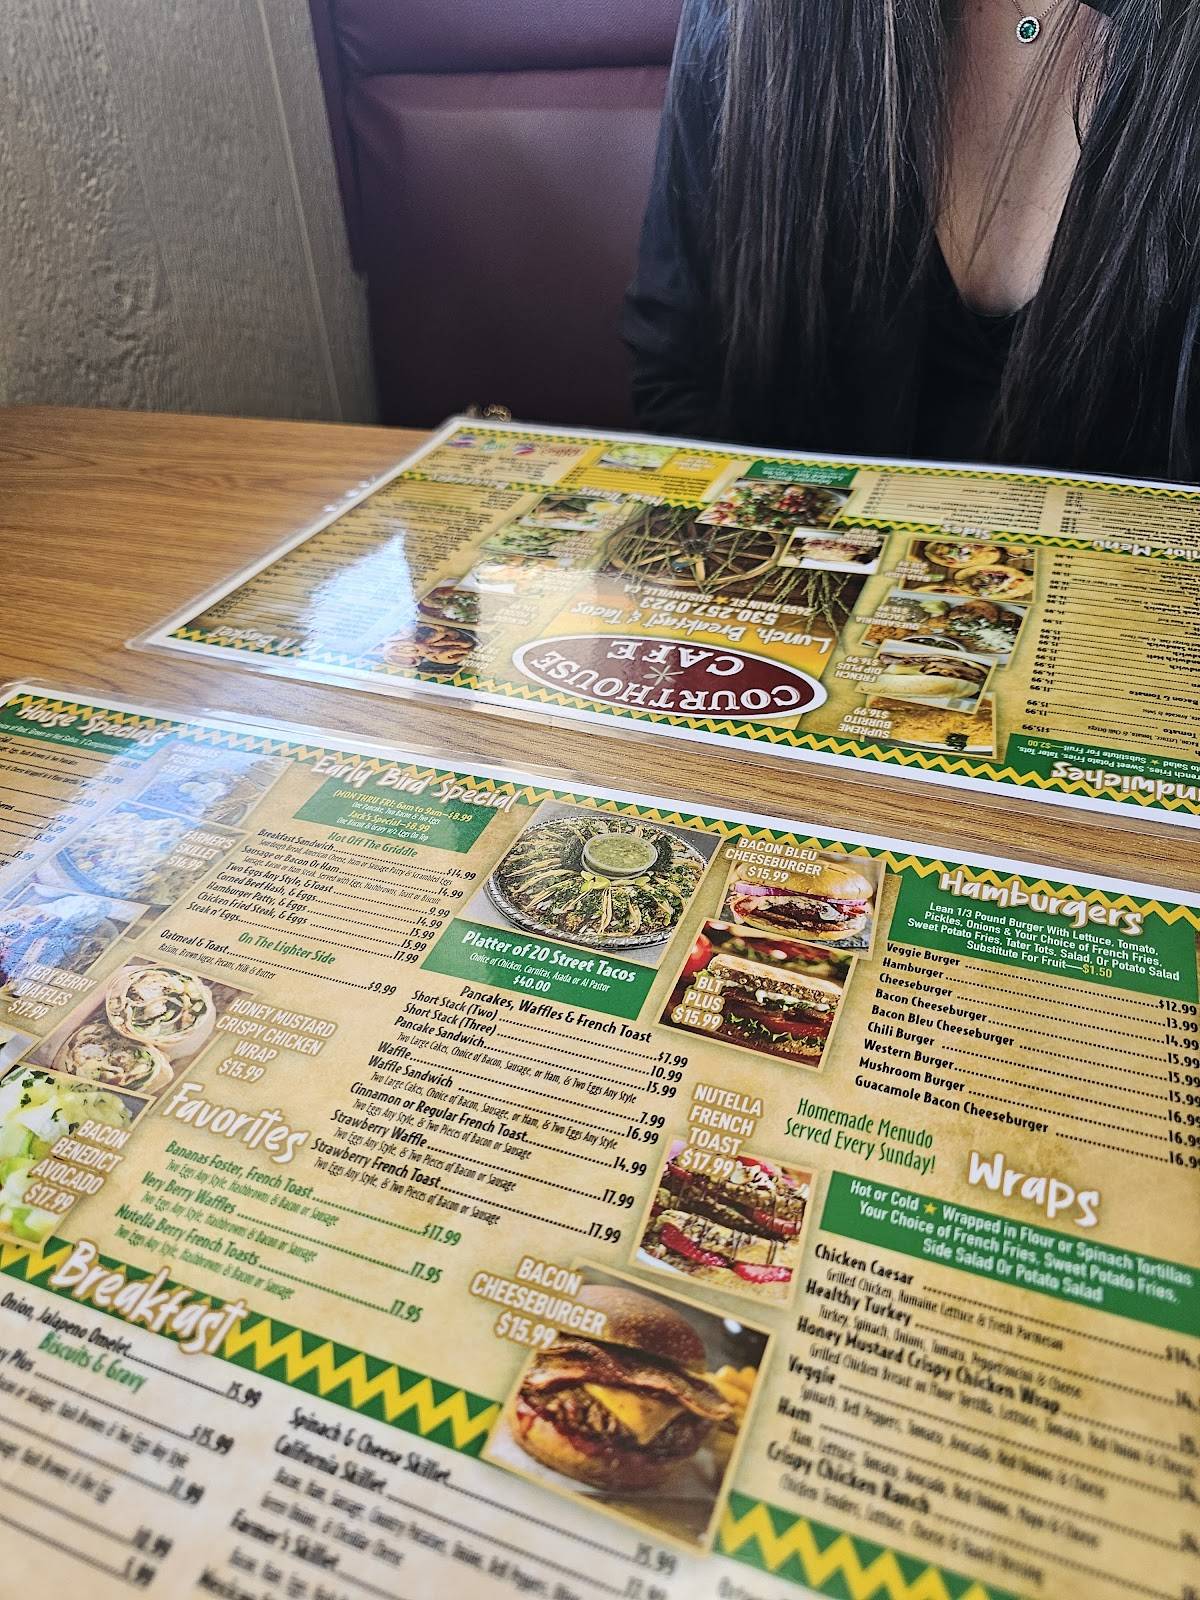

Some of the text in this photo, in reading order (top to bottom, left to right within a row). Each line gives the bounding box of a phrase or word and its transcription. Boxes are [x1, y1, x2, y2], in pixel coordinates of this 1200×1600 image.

[938, 524, 993, 540] Sides
[1090, 539, 1151, 557] Menu
[639, 593, 778, 626] 530.257.0923
[605, 639, 744, 676] CAFE
[835, 662, 882, 675] DIP PLUS
[845, 655, 879, 666] $16.99
[530, 649, 800, 711] COURTHOUSE
[834, 669, 878, 683] FRENCH
[16, 704, 78, 729] House
[77, 715, 165, 747] Specials
[842, 714, 893, 729] BURRITO
[852, 706, 889, 719] $16.99
[837, 723, 891, 739] SUPREME
[1050, 760, 1200, 801] ndwiches
[1164, 761, 1188, 772] Salad
[312, 756, 521, 813] Early Bird Special
[257, 829, 477, 881] Breakfast Sandwich $14.99
[327, 831, 418, 858] Hot Off The Griddle
[738, 838, 818, 862] BACON BLEU
[723, 848, 823, 876] CHEESEBURGER
[746, 866, 790, 884] $15.99
[940, 870, 1144, 936] Hamburgers
[929, 902, 954, 915] Lean
[957, 907, 973, 918] 1/3
[974, 911, 1006, 925] Pound
[1008, 917, 1044, 932] Burger
[1046, 925, 1070, 938] With
[238, 932, 336, 965] On The Lighter Side
[461, 930, 636, 982] Platter of 20 Street Tacos
[907, 917, 939, 932] Sweet
[940, 924, 972, 940] Potato
[1006, 937, 1031, 950] Tater
[1096, 956, 1109, 967] Or
[1111, 958, 1146, 974] Potato
[1147, 966, 1180, 981] Salad
[965, 939, 1018, 960] Substitute
[1021, 951, 1039, 963] For
[966, 919, 1001, 934] Onions
[1003, 927, 1011, 936] &
[1014, 928, 1037, 941] Your
[1040, 934, 1076, 949] Choice
[1078, 943, 1089, 952] of
[1092, 944, 1129, 960] French
[13, 981, 75, 1007] WAFFLES
[22, 964, 98, 993] VERY BERRY
[513, 975, 551, 992] $40.00
[696, 976, 725, 993] BLT
[887, 942, 1197, 1016] Veggie Burger $12.99
[4, 1000, 51, 1021] $17.99
[684, 991, 724, 1012] PLUS
[226, 998, 339, 1039] HONEY MUSTARD
[411, 990, 689, 1068] Short Stack (Two) $7.99
[518, 999, 564, 1020] Waffles
[564, 1011, 575, 1023] &
[576, 1013, 617, 1034] French
[619, 1023, 652, 1043] Toast
[672, 1006, 722, 1031] $15.99
[213, 1015, 325, 1057] CRISPY CHICKEN
[230, 1040, 279, 1065] WRAP
[216, 1058, 266, 1083] $15.99
[693, 1084, 765, 1117] NUTELLA
[74, 1120, 133, 1150] BACON
[163, 1083, 308, 1163] Favorites
[688, 1105, 756, 1138] FRENCH
[796, 1098, 934, 1149] Homemade Menudo
[48, 1137, 125, 1174] BENEDICT
[686, 1127, 743, 1158] TOAST
[784, 1117, 936, 1176] Served Every Sunday!
[28, 1157, 107, 1196] AVOCADO
[679, 1148, 735, 1180] $17.99
[20, 1183, 78, 1215] $17.99
[968, 1151, 1100, 1227] Wraps
[517, 1257, 583, 1297] BACON
[51, 1241, 246, 1355] Breakfast
[471, 1272, 607, 1336] CHEESEBURGER
[495, 1313, 558, 1349] $15.99
